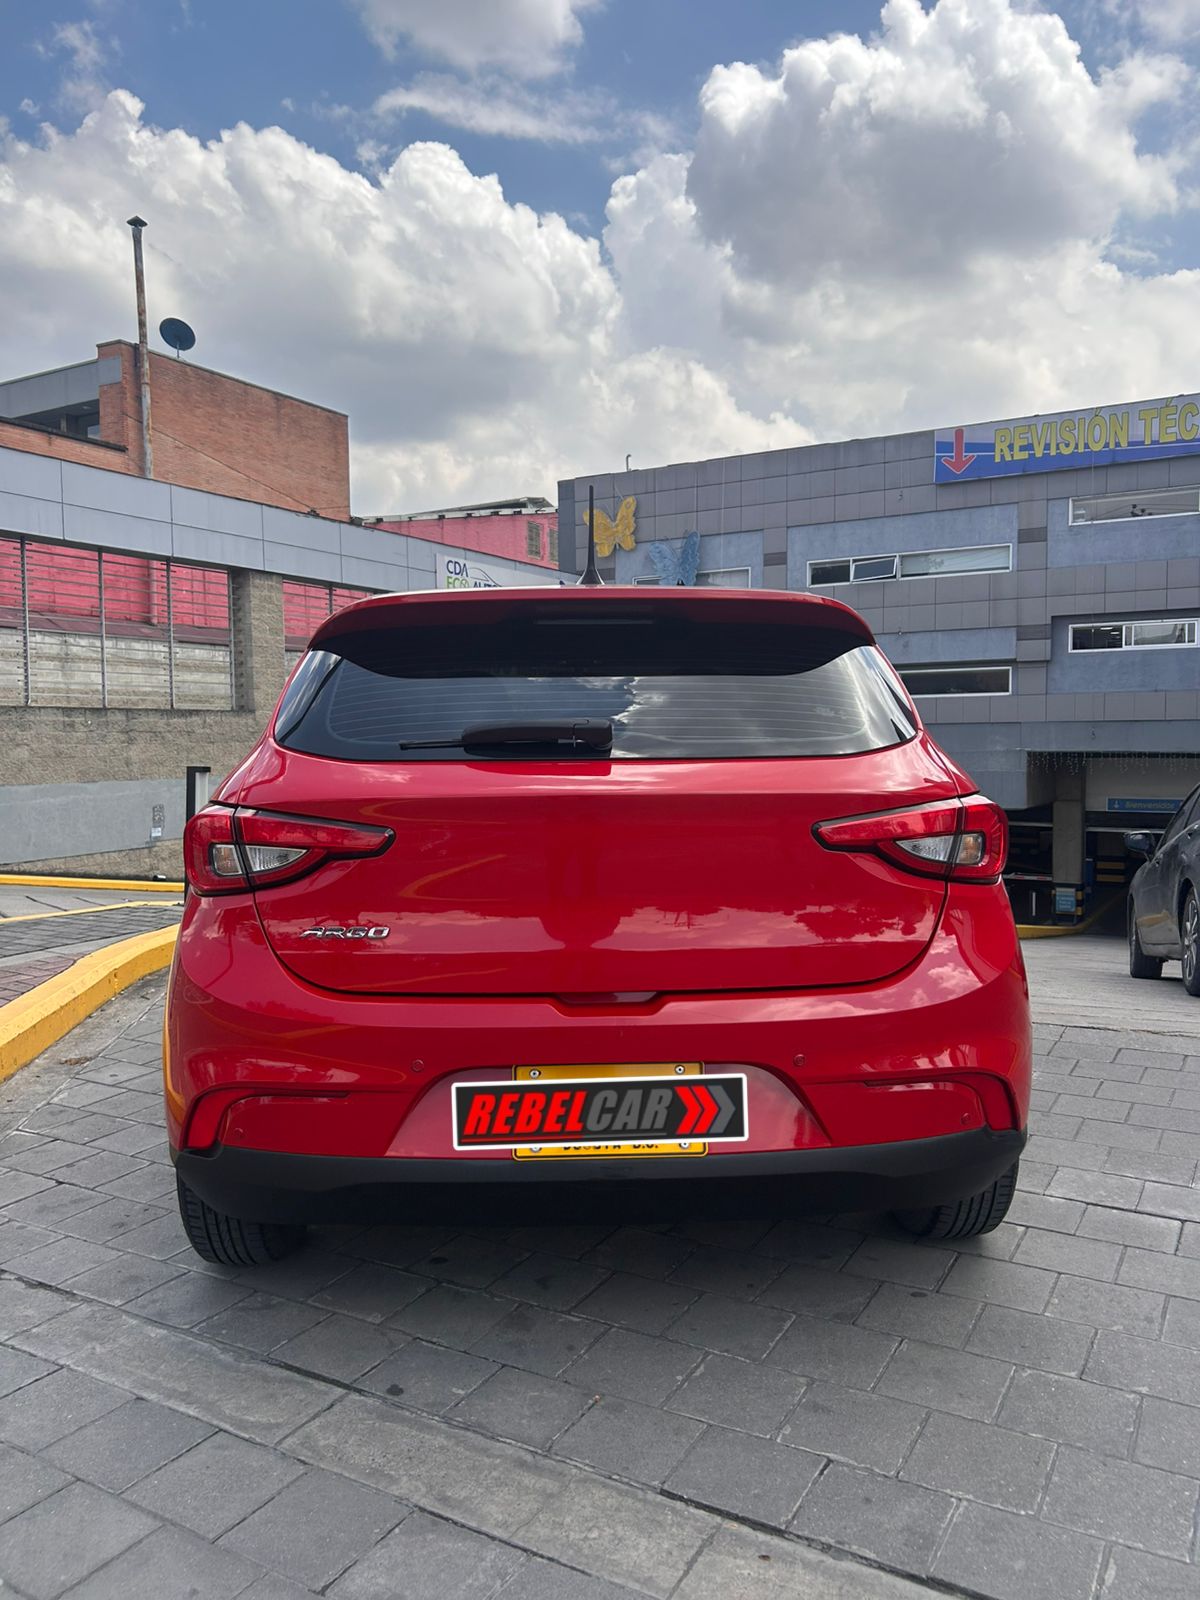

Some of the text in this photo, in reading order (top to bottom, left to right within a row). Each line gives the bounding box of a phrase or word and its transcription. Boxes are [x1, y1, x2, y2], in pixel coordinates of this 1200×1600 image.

[994, 397, 1200, 463] REVISIÓN TÉC
[446, 560, 469, 577] CDA
[300, 926, 390, 939] ARGO
